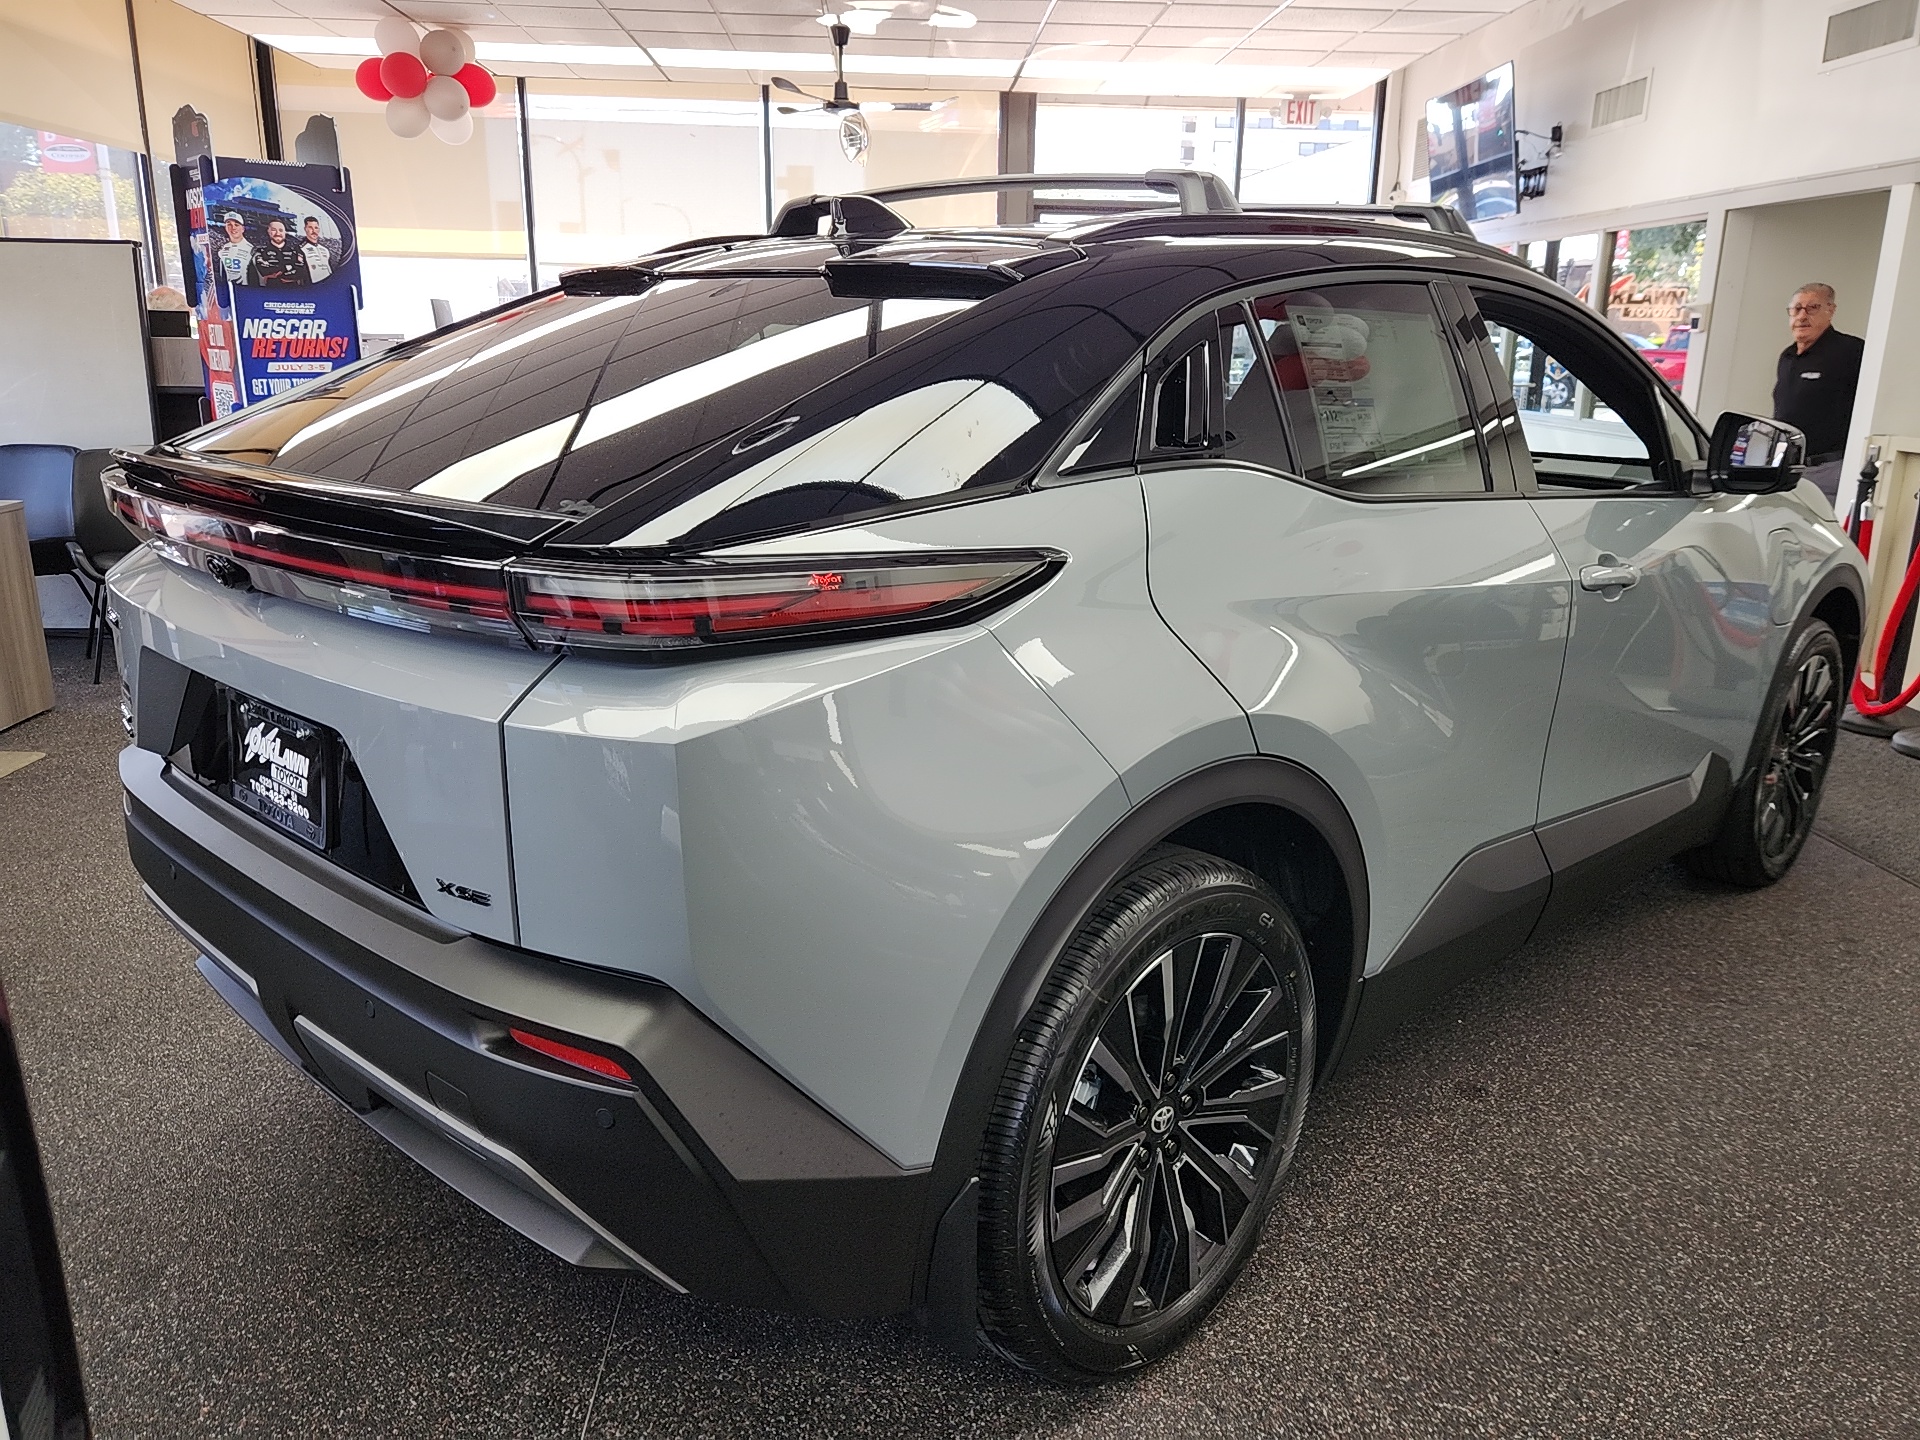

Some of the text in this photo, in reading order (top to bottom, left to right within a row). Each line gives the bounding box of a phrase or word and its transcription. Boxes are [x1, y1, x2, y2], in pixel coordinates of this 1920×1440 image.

[1287, 101, 1316, 124] EXIT
[243, 318, 328, 338] NASCAR
[252, 337, 349, 358] RETURNS!
[252, 378, 269, 396] GET
[268, 378, 292, 395] YOUR
[275, 766, 304, 791] TOYOTA
[249, 778, 310, 820] 708-423-5200
[258, 799, 294, 828] TOYOTA
[435, 877, 492, 907] XSE
